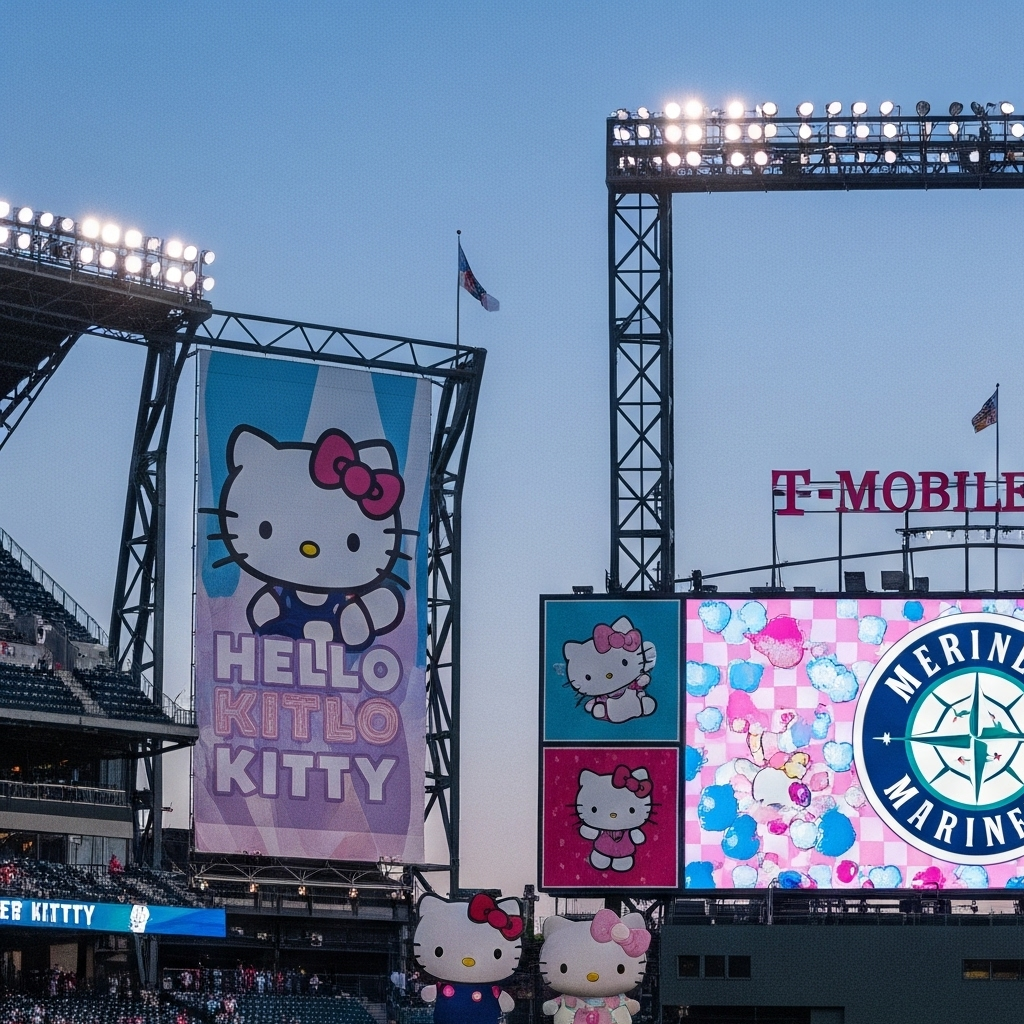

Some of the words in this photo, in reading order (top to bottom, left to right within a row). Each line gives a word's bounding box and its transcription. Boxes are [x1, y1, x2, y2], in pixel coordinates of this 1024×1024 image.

[213, 631, 403, 694] HELLO
[214, 687, 401, 745] KITLO
[213, 743, 400, 804] KITTY
